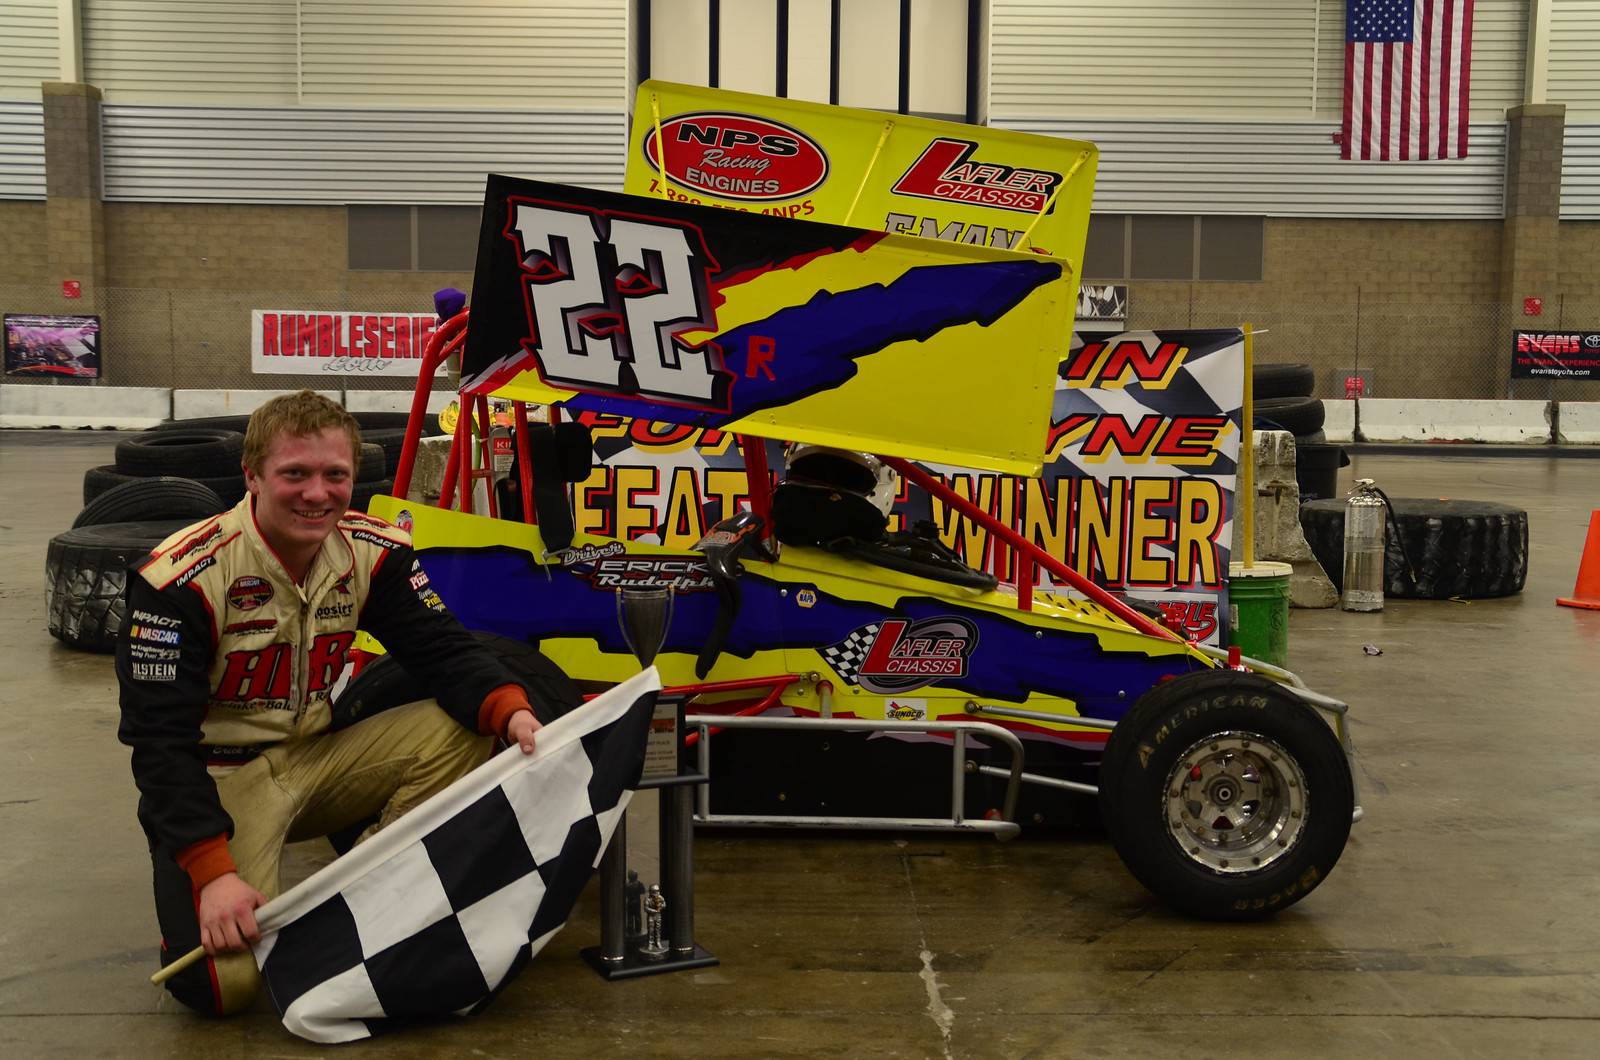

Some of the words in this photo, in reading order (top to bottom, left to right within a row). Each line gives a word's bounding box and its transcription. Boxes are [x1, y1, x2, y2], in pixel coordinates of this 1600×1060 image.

[677, 122, 800, 157] NPS
[699, 148, 771, 176] Racing
[685, 166, 779, 193] ENGINES
[933, 183, 1040, 209] CHASSIS
[512, 204, 715, 400] 22
[263, 313, 441, 358] RUMBLESERIE
[1518, 334, 1580, 355] EVANS
[746, 335, 776, 381] R
[1531, 368, 1590, 376] evanstoyota.com
[355, 531, 401, 549] IMPACT
[930, 473, 1223, 591] WINNER
[176, 557, 212, 587] IMPACT
[600, 560, 710, 572] ERICK
[598, 573, 716, 590] Rudolph
[140, 627, 179, 644] NASCAR
[886, 659, 957, 674] CHASSIS
[888, 710, 922, 719] SUNOCO
[1138, 695, 1268, 769] AMERICAN
